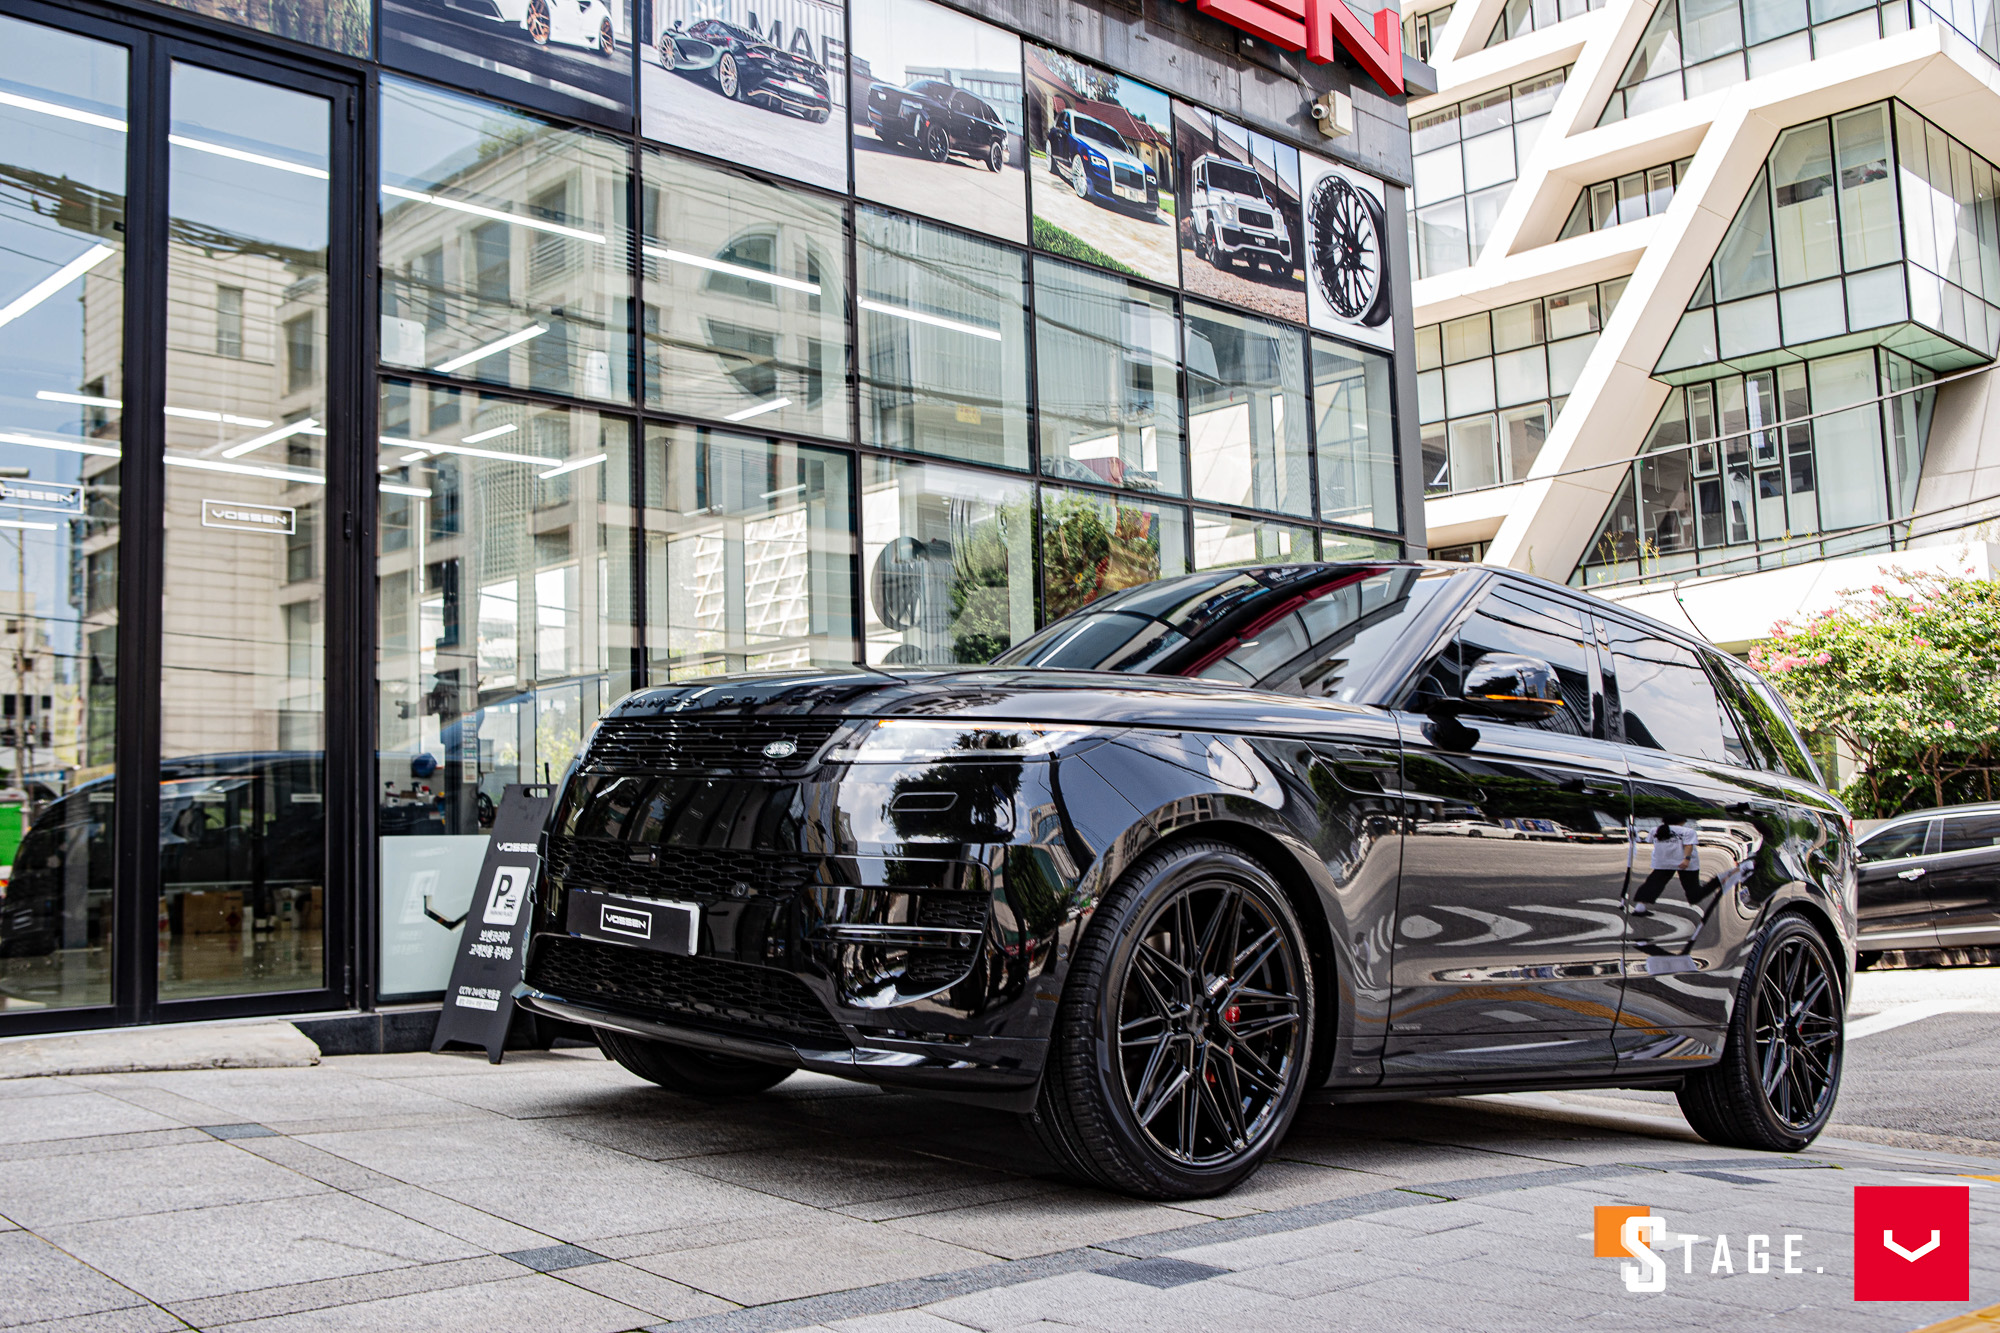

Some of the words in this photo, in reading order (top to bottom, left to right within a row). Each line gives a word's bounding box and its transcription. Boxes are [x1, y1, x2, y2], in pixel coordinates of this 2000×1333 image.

[211, 508, 288, 525] VOSSEN
[493, 875, 512, 907] P
[605, 913, 646, 929] VOSSEN
